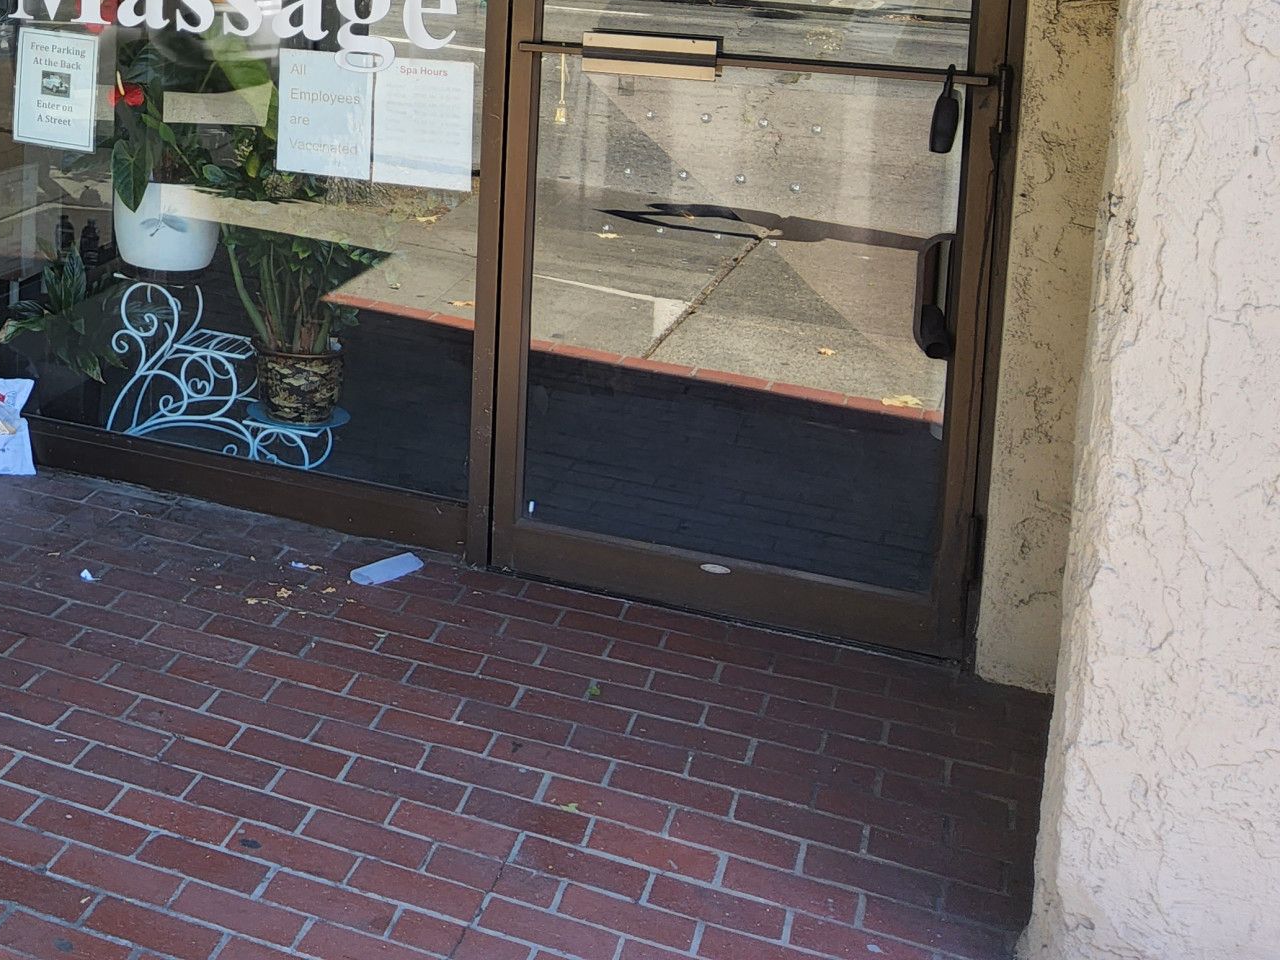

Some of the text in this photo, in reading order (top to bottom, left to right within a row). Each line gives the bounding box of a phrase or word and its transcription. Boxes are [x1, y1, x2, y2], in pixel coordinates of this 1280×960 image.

[30, 41, 86, 58] Free Parking
[32, 56, 81, 71] At the Back
[290, 63, 306, 75] All
[400, 65, 449, 77] Spa Hours
[290, 87, 361, 106] Employees
[36, 99, 73, 112] Enter on
[36, 114, 72, 127] A Street
[289, 114, 310, 126] are
[289, 137, 359, 156] Vaccinated
